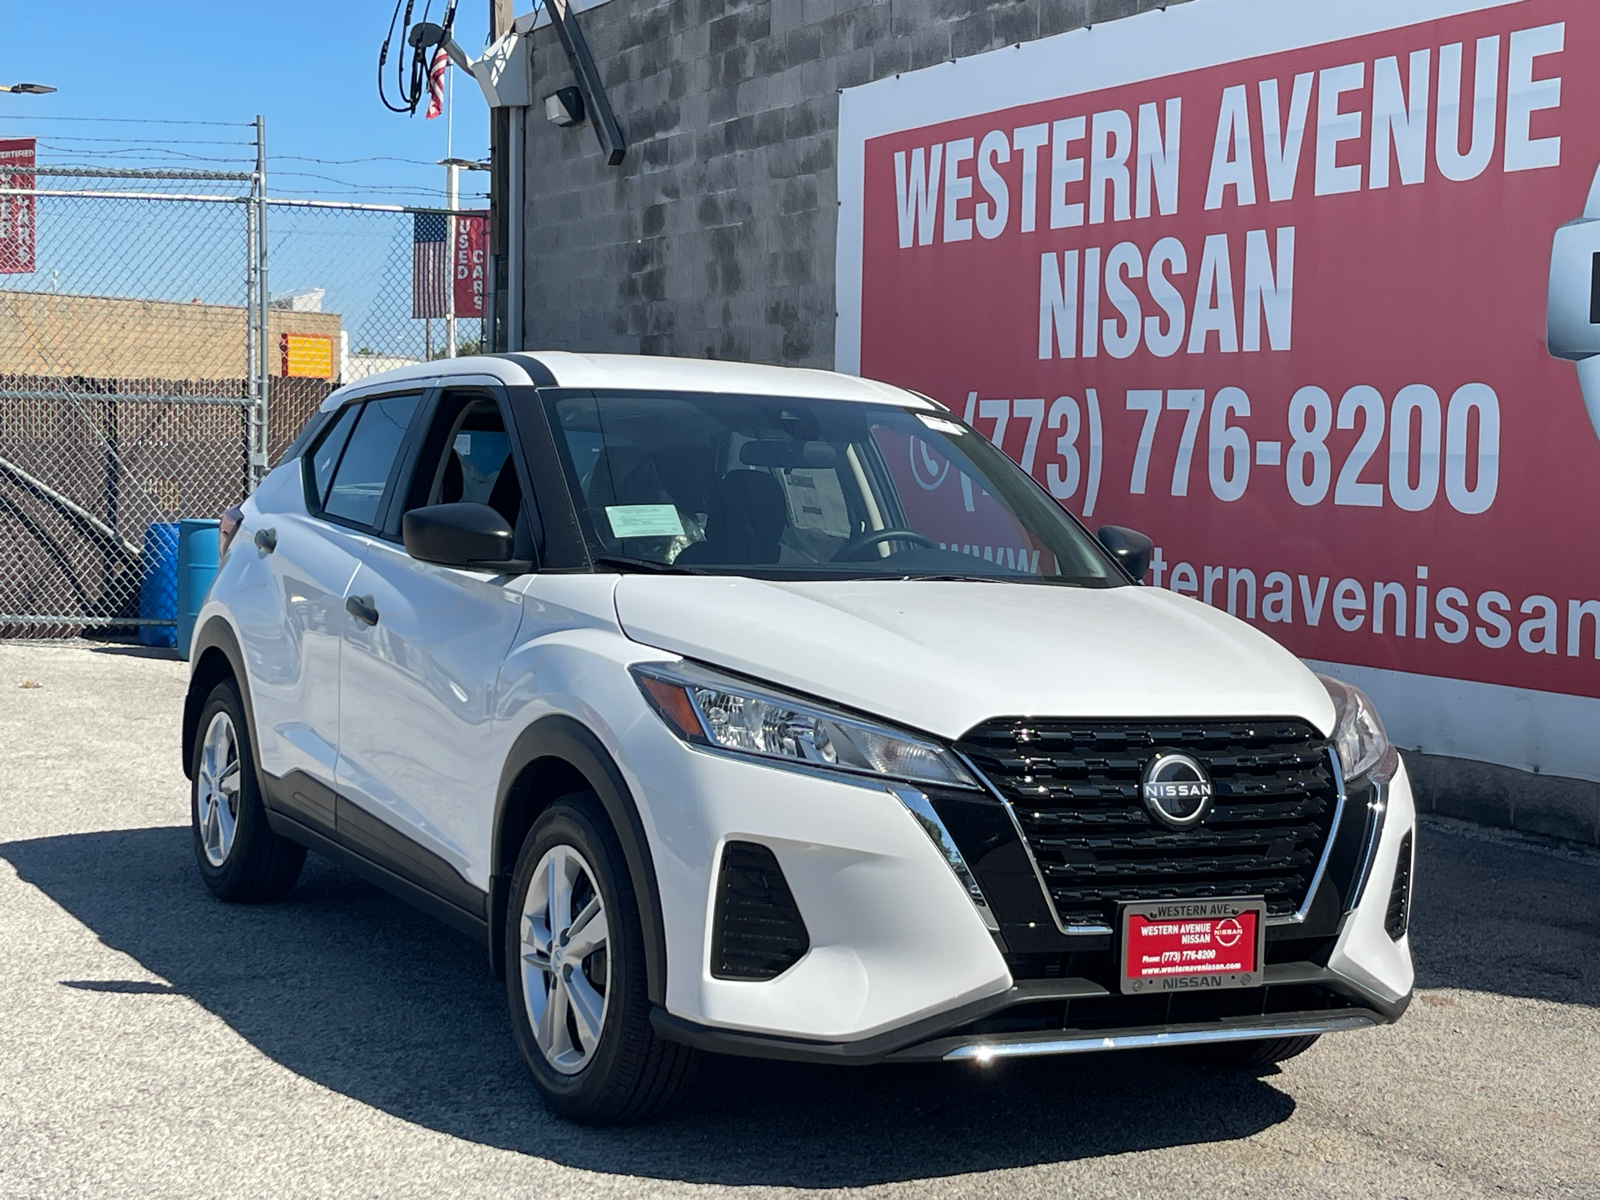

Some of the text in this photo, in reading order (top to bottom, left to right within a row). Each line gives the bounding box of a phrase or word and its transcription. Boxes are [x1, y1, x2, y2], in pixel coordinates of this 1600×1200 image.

[894, 22, 1566, 249] WESTERN AVENUE
[0, 150, 35, 158] ERTIFIED
[457, 219, 471, 280] USED
[472, 250, 484, 310] CARS
[1038, 226, 1296, 360] NISSAN
[959, 382, 1500, 517] (773) 776-8200
[1145, 783, 1211, 797] NISSAN
[1157, 904, 1207, 917] WESTERN
[1141, 923, 1211, 936] WESTERN AVENUE
[1181, 934, 1211, 944] NISSAN
[1161, 951, 1180, 964] (773)
[1182, 949, 1216, 960] 776-8200
[1141, 963, 1241, 975] www.westernavenissan.com
[1163, 976, 1222, 989] NISSAN
